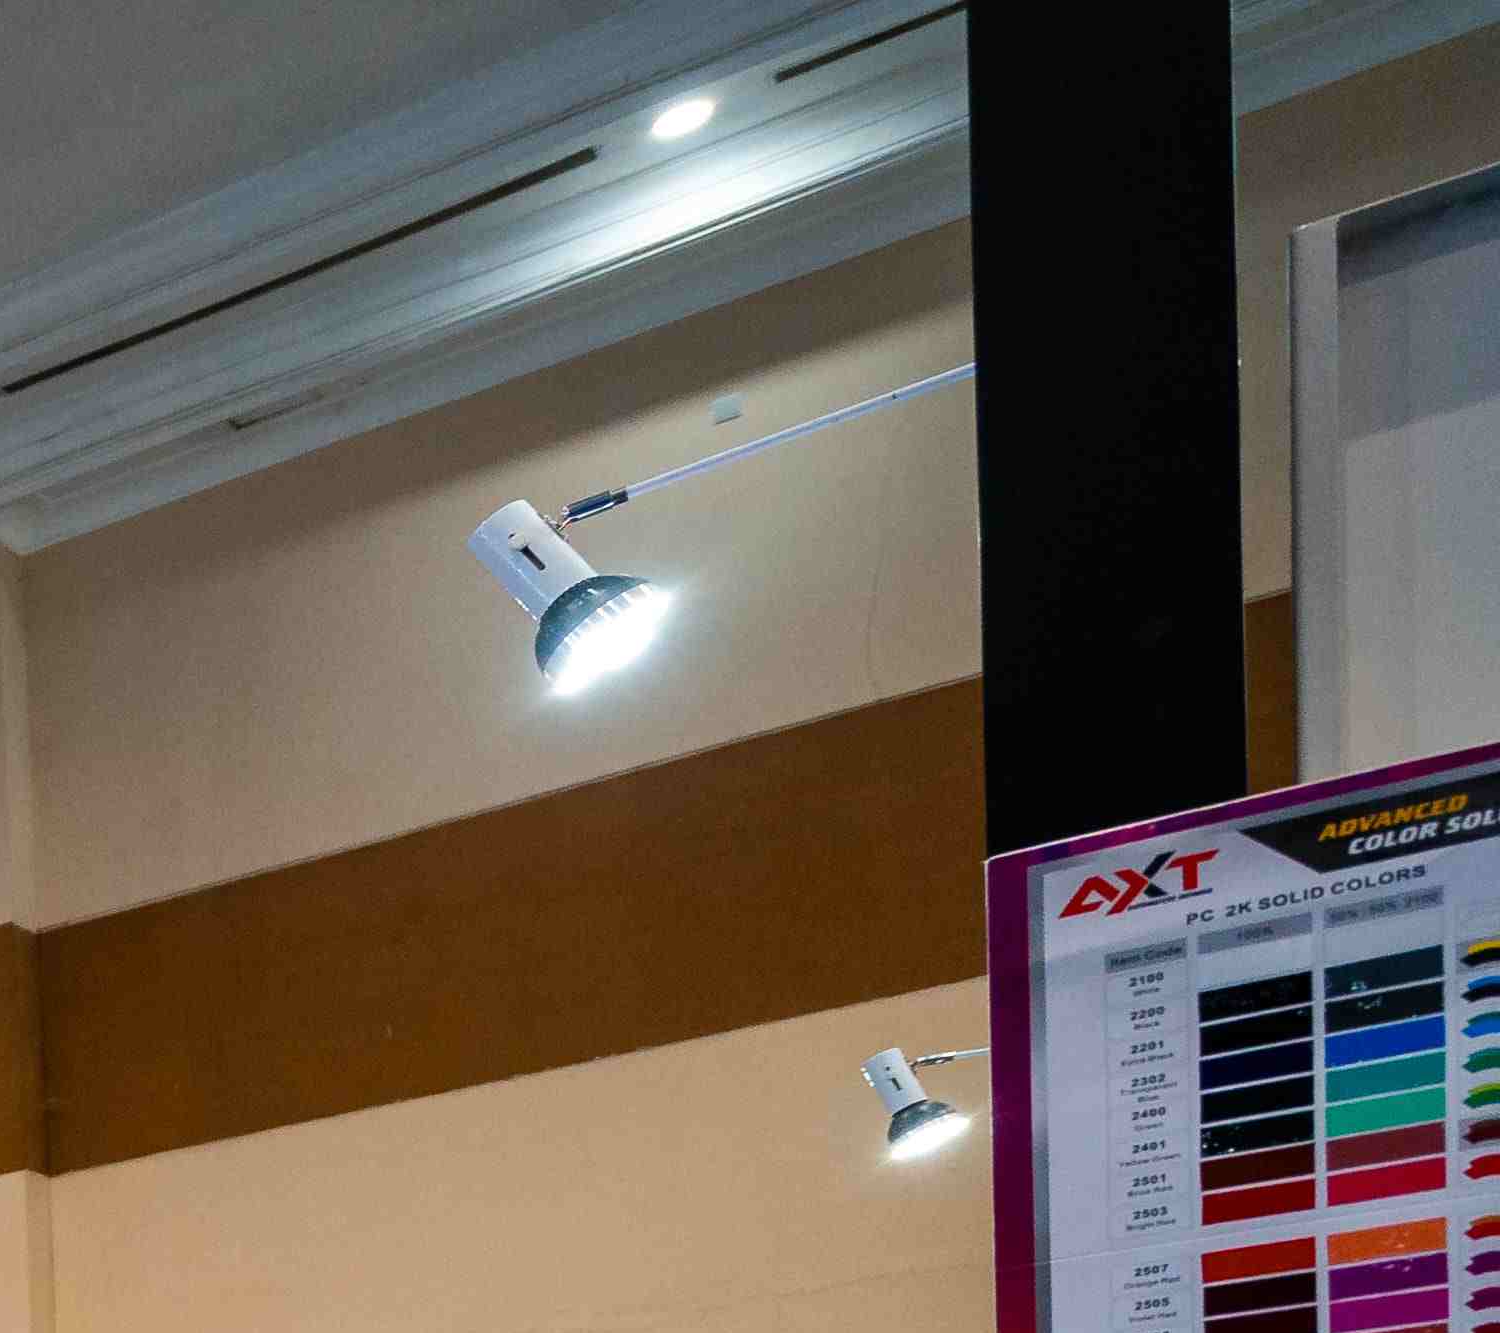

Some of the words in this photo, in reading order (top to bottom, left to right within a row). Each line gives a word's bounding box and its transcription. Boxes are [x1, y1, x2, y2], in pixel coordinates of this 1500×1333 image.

[1318, 794, 1468, 842] ADVANCED
[1348, 817, 1440, 855] COLOR
[1445, 804, 1500, 837] SOL
[1058, 849, 1220, 919] AXT
[1186, 909, 1215, 926] PC
[1226, 902, 1252, 918] 2K
[1258, 886, 1324, 910] SOLID
[1330, 864, 1426, 896] COLORS
